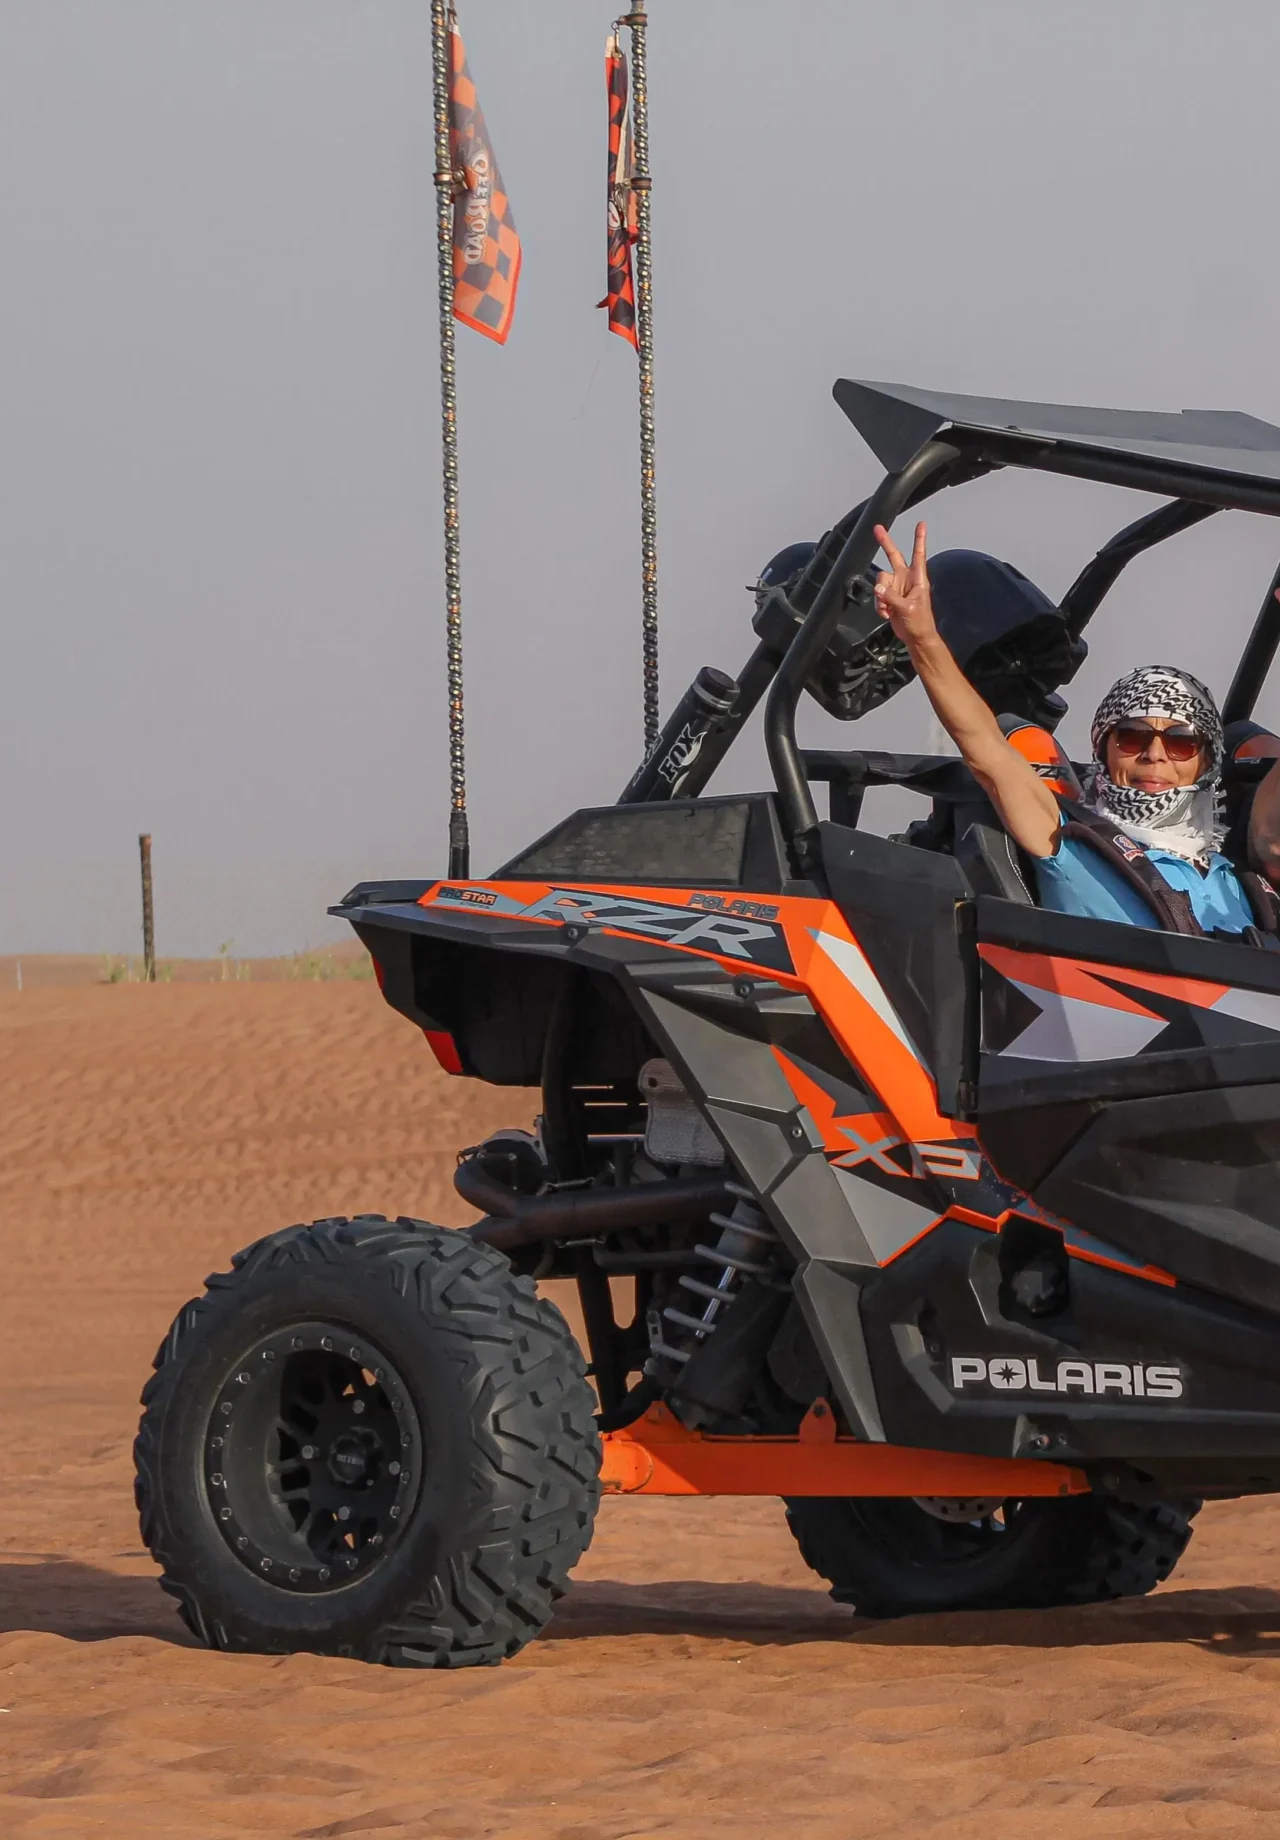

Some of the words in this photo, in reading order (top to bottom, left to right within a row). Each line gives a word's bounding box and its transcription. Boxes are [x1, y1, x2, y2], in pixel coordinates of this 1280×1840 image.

[658, 723, 703, 783] FOX
[517, 889, 777, 959] RZR
[687, 892, 780, 921] POLARIS
[829, 1126, 982, 1180] XP
[951, 1357, 1183, 1398] POLARIS
